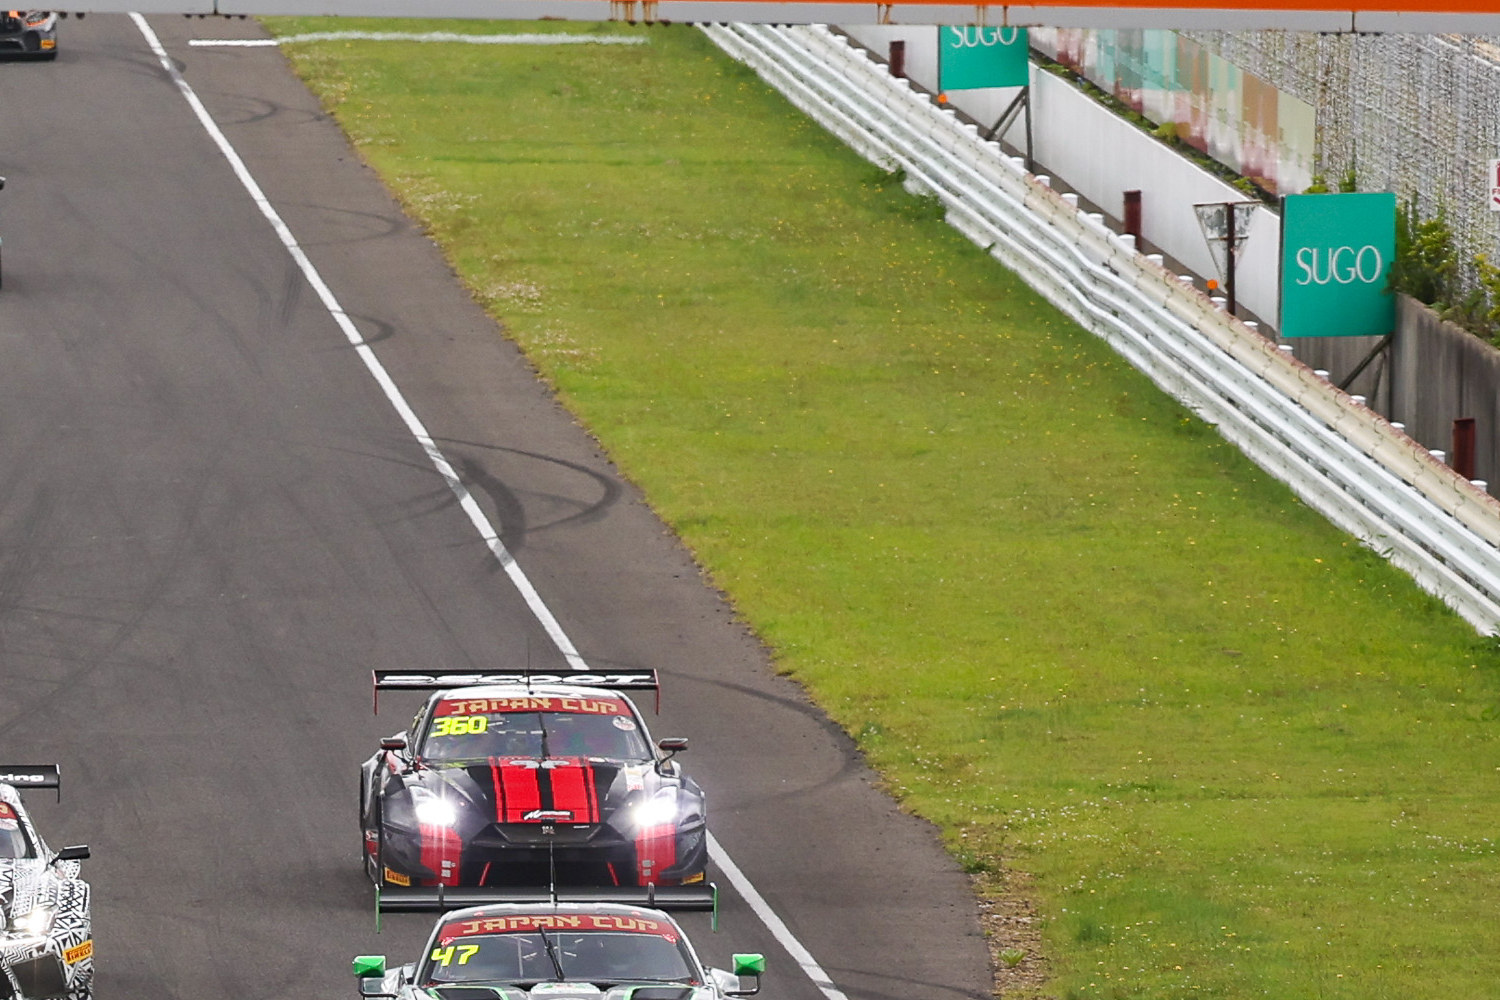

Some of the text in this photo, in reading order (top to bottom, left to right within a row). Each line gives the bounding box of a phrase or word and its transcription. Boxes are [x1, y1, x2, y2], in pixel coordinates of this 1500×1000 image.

[1296, 245, 1382, 285] SUGO
[450, 698, 618, 714] JAPAN CUP
[430, 716, 488, 738] 360
[461, 915, 658, 934] JAPAN CUP
[430, 944, 479, 967] 47
